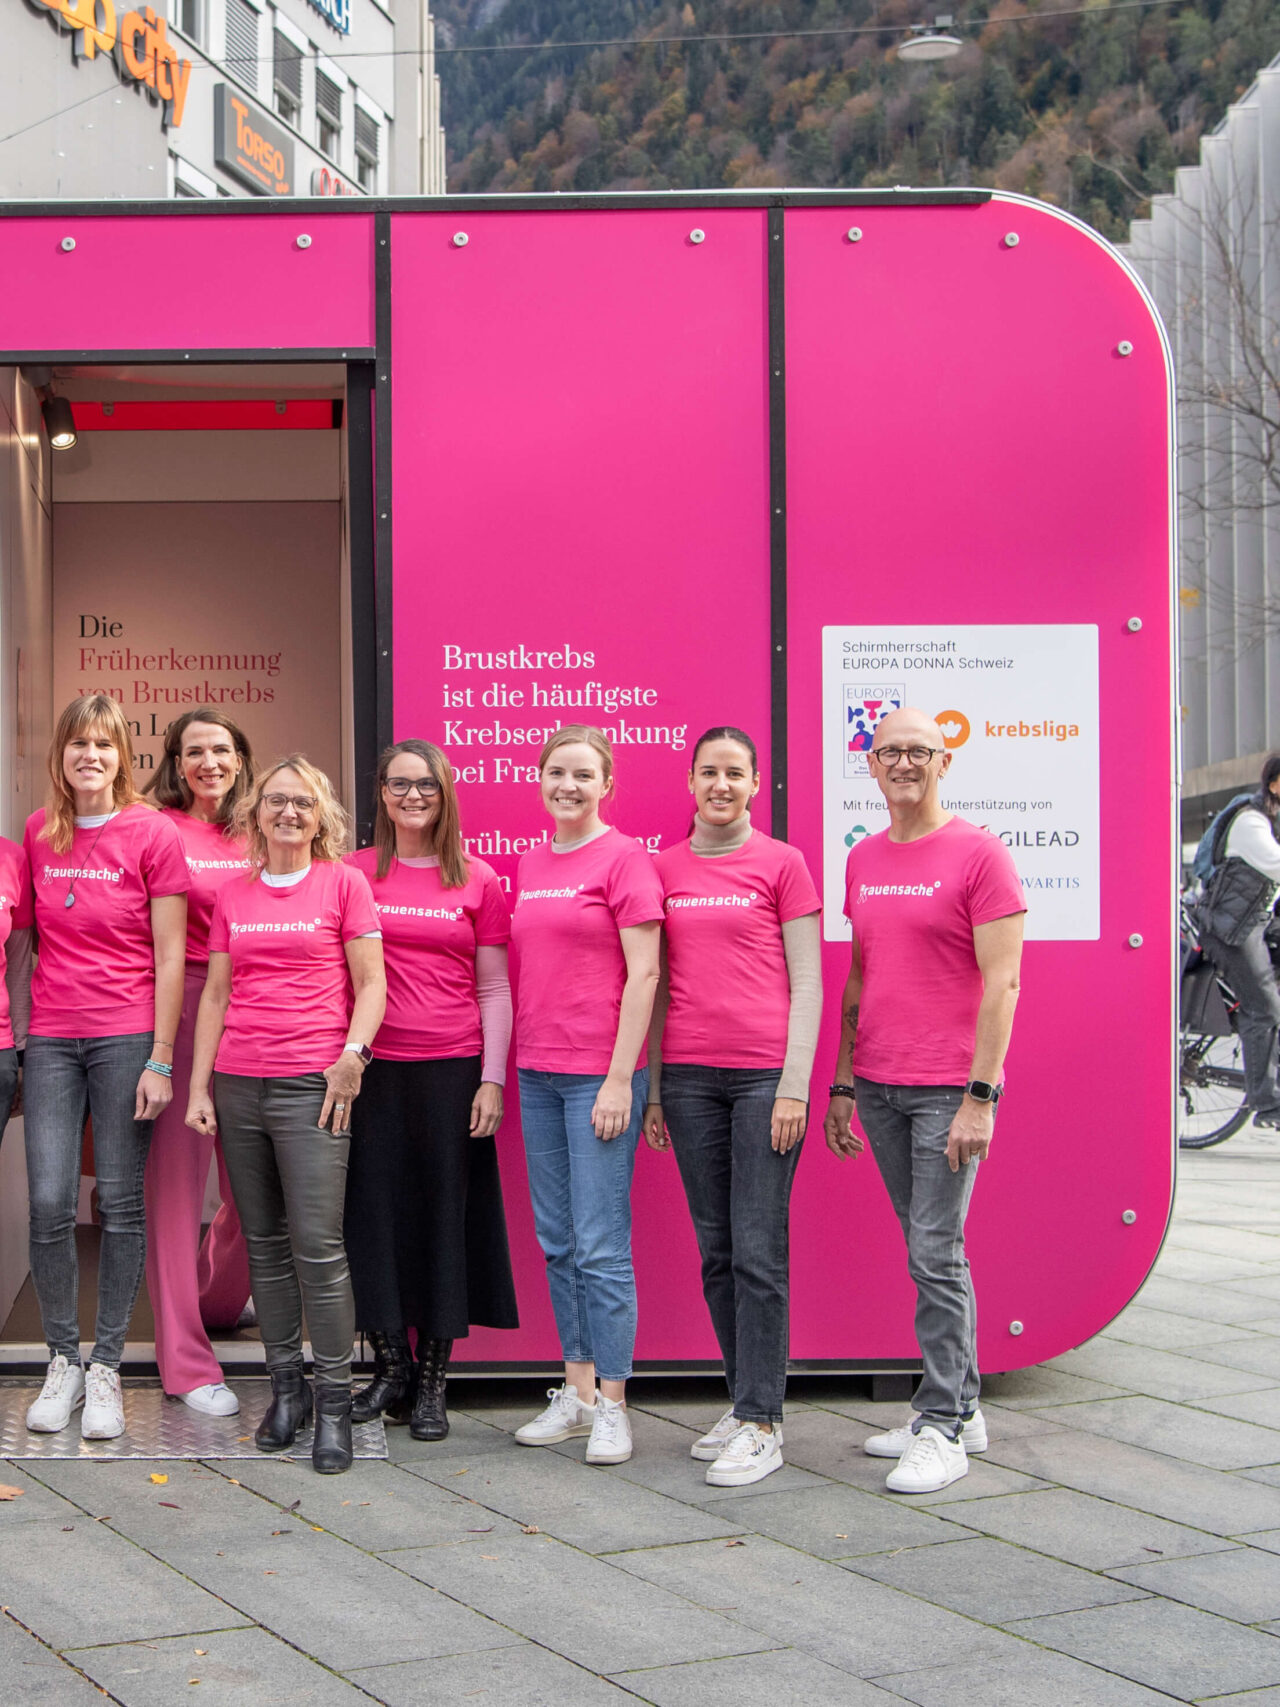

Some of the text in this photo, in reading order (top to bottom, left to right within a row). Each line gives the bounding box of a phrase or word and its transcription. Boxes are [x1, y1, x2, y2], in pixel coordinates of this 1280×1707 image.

[121, 6, 192, 127] city
[78, 614, 123, 638] Die
[443, 645, 595, 670] Brustkrebs
[842, 641, 956, 653] Schirmherrschaft
[78, 648, 281, 676] Früherkennung
[842, 656, 1014, 669] EUROPA DONNA Schweiz
[133, 680, 275, 704] Brustkrebs
[443, 682, 658, 713] ist die häufigste
[846, 688, 901, 699] EUROPA
[443, 720, 687, 750] Krebsernkung
[985, 721, 1080, 741] krebsliga
[843, 800, 861, 811] Mit
[941, 799, 1027, 812] Unterstützung
[1031, 801, 1052, 810] von
[1000, 830, 1080, 847] GILEAD
[1020, 877, 1080, 889] VARTIS
